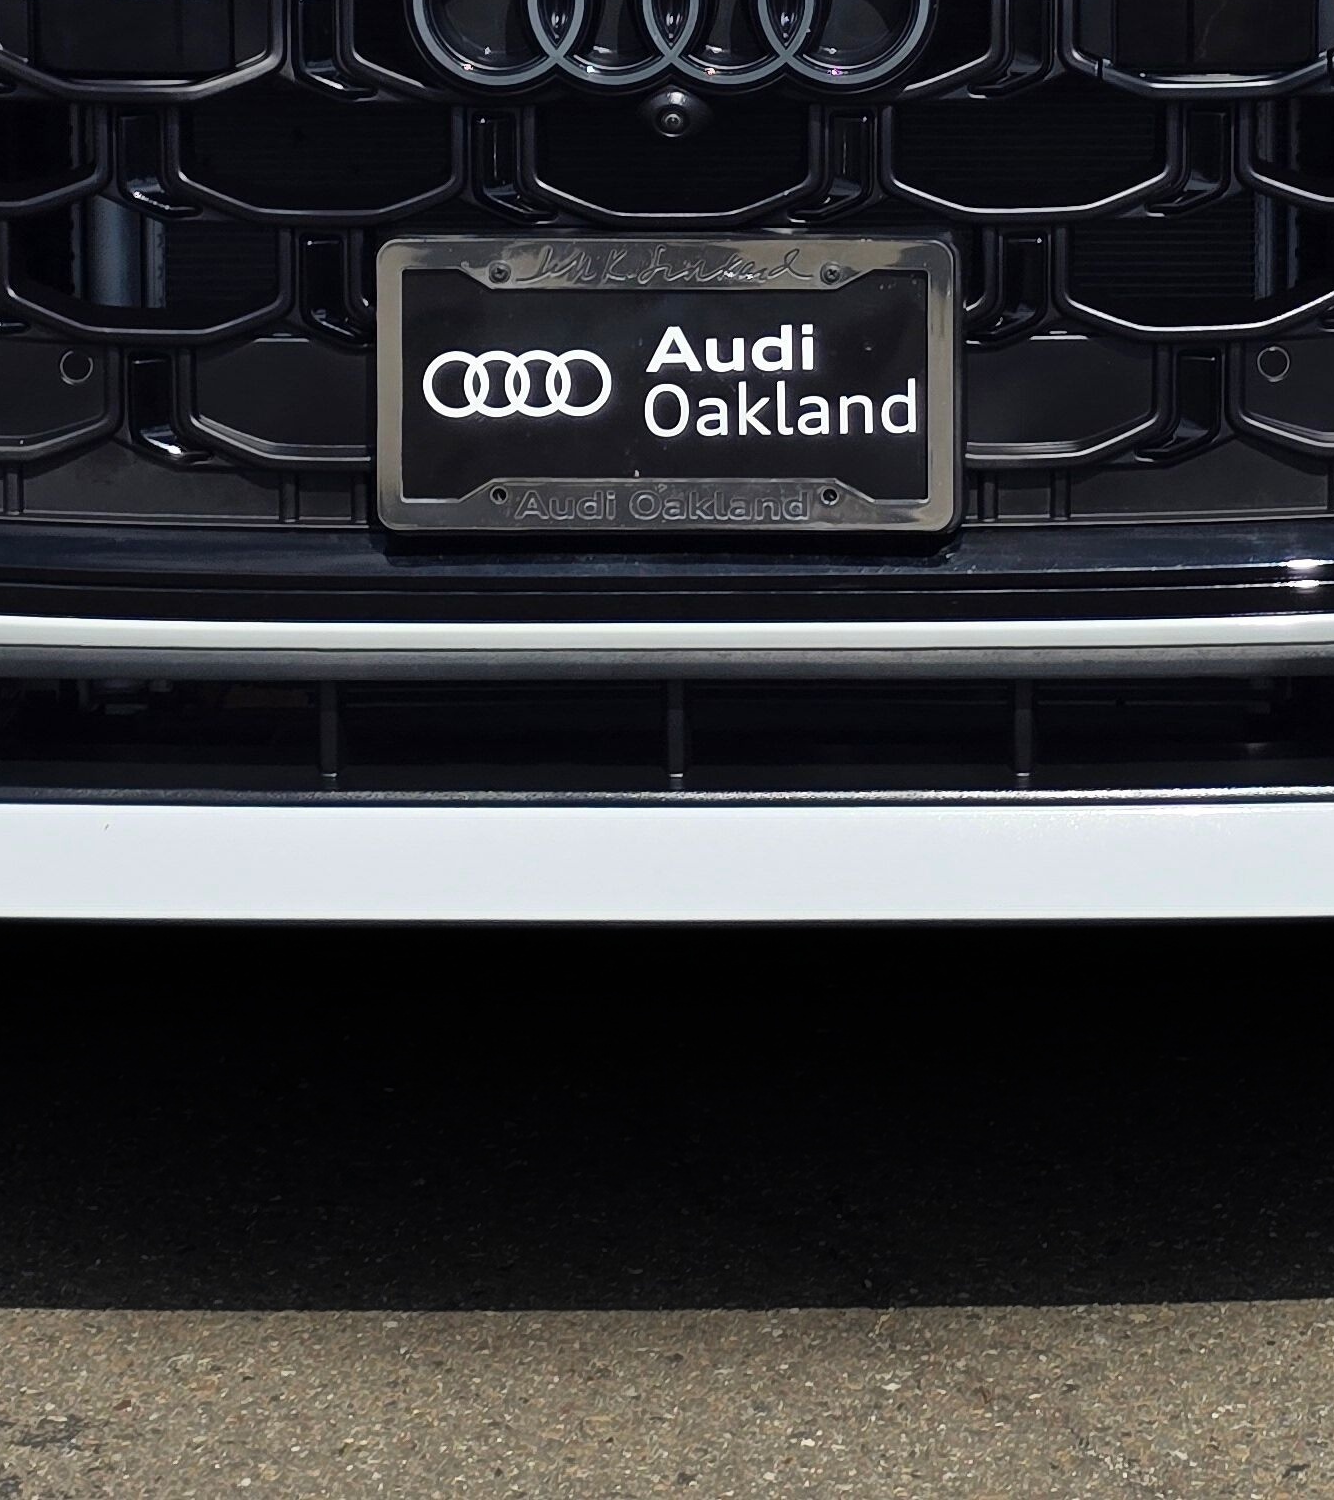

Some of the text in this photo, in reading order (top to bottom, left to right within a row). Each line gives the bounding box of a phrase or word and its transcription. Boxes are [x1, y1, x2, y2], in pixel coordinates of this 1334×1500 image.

[645, 324, 815, 373] Audi
[644, 378, 917, 437] Oakland
[514, 490, 810, 520] Audi Oakland
